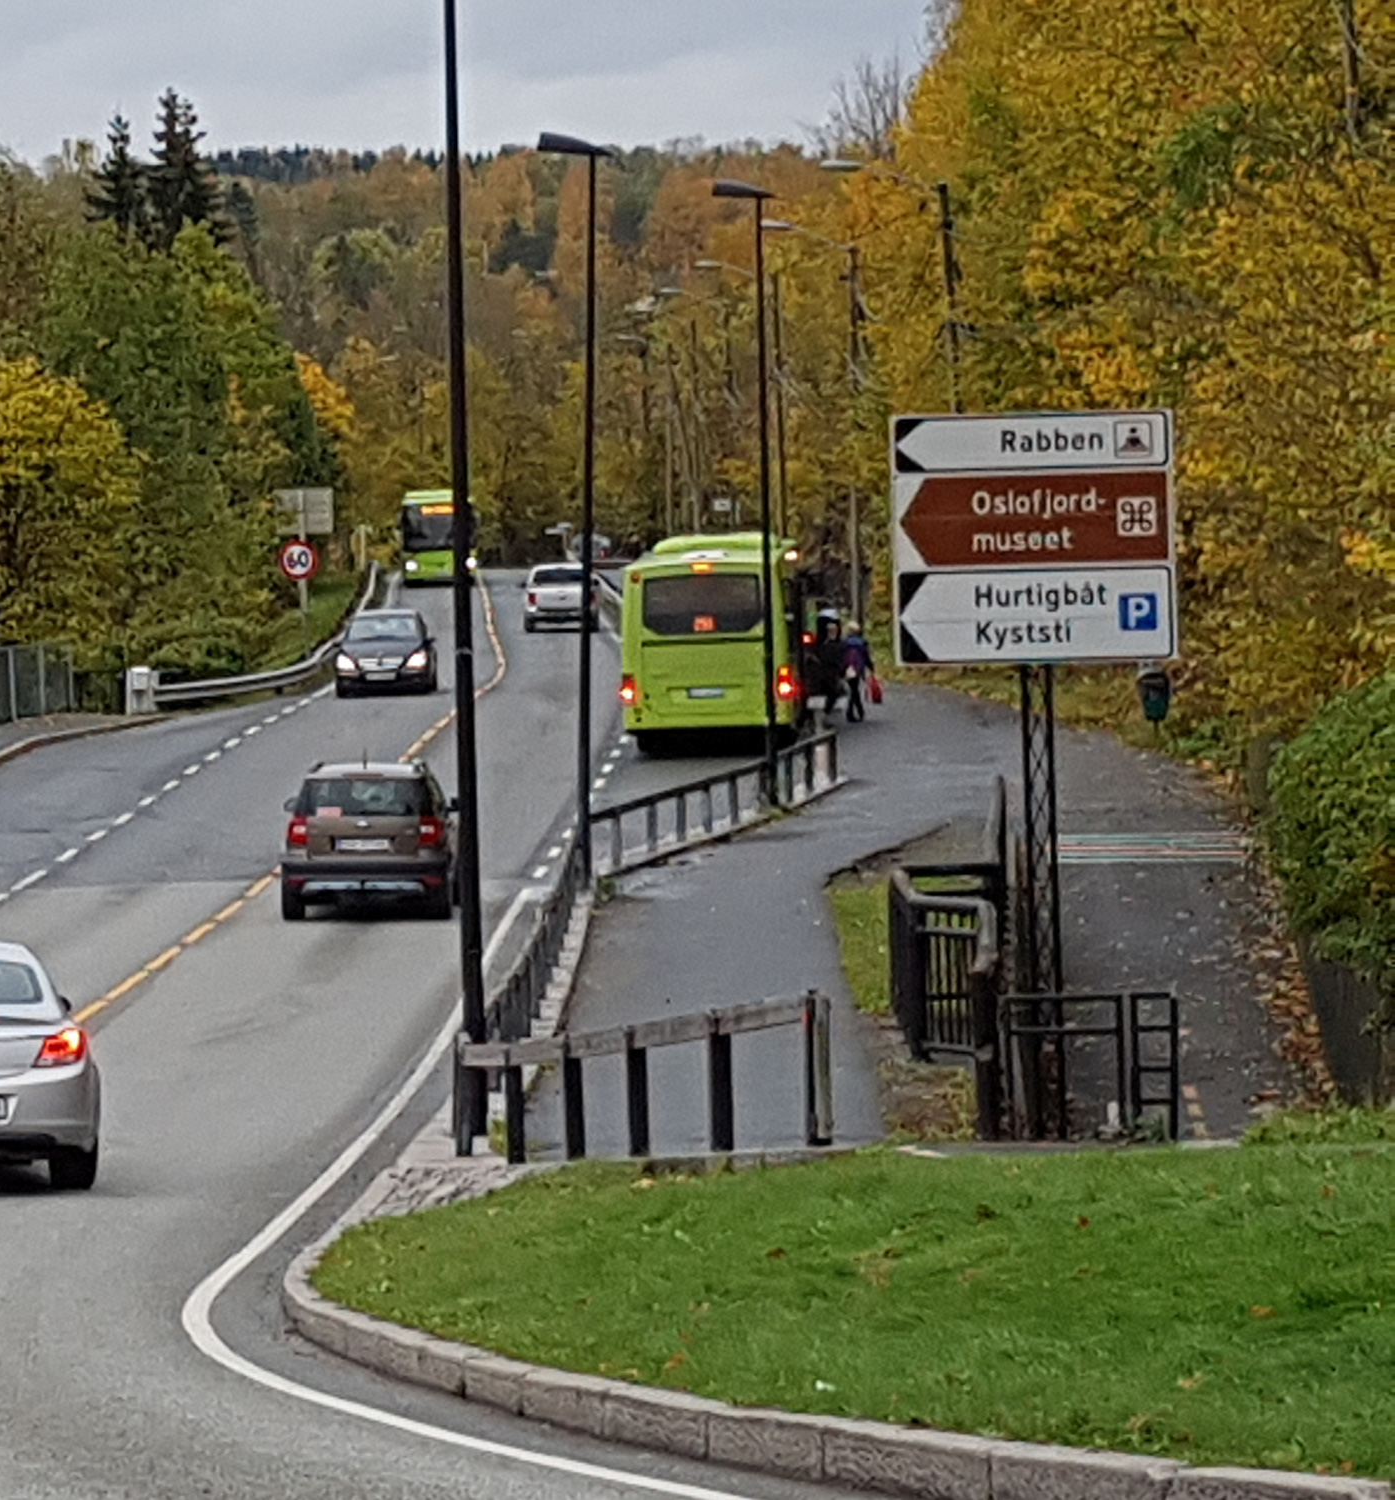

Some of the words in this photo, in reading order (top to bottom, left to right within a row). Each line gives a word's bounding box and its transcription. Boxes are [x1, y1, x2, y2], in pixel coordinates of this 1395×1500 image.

[1000, 427, 1104, 452] Rabben
[971, 486, 1107, 519] Oslofjord-
[971, 526, 1074, 552] museet
[286, 550, 309, 569] 60
[974, 581, 1107, 612] Hurtigbåt
[976, 618, 1071, 650] Kyststi
